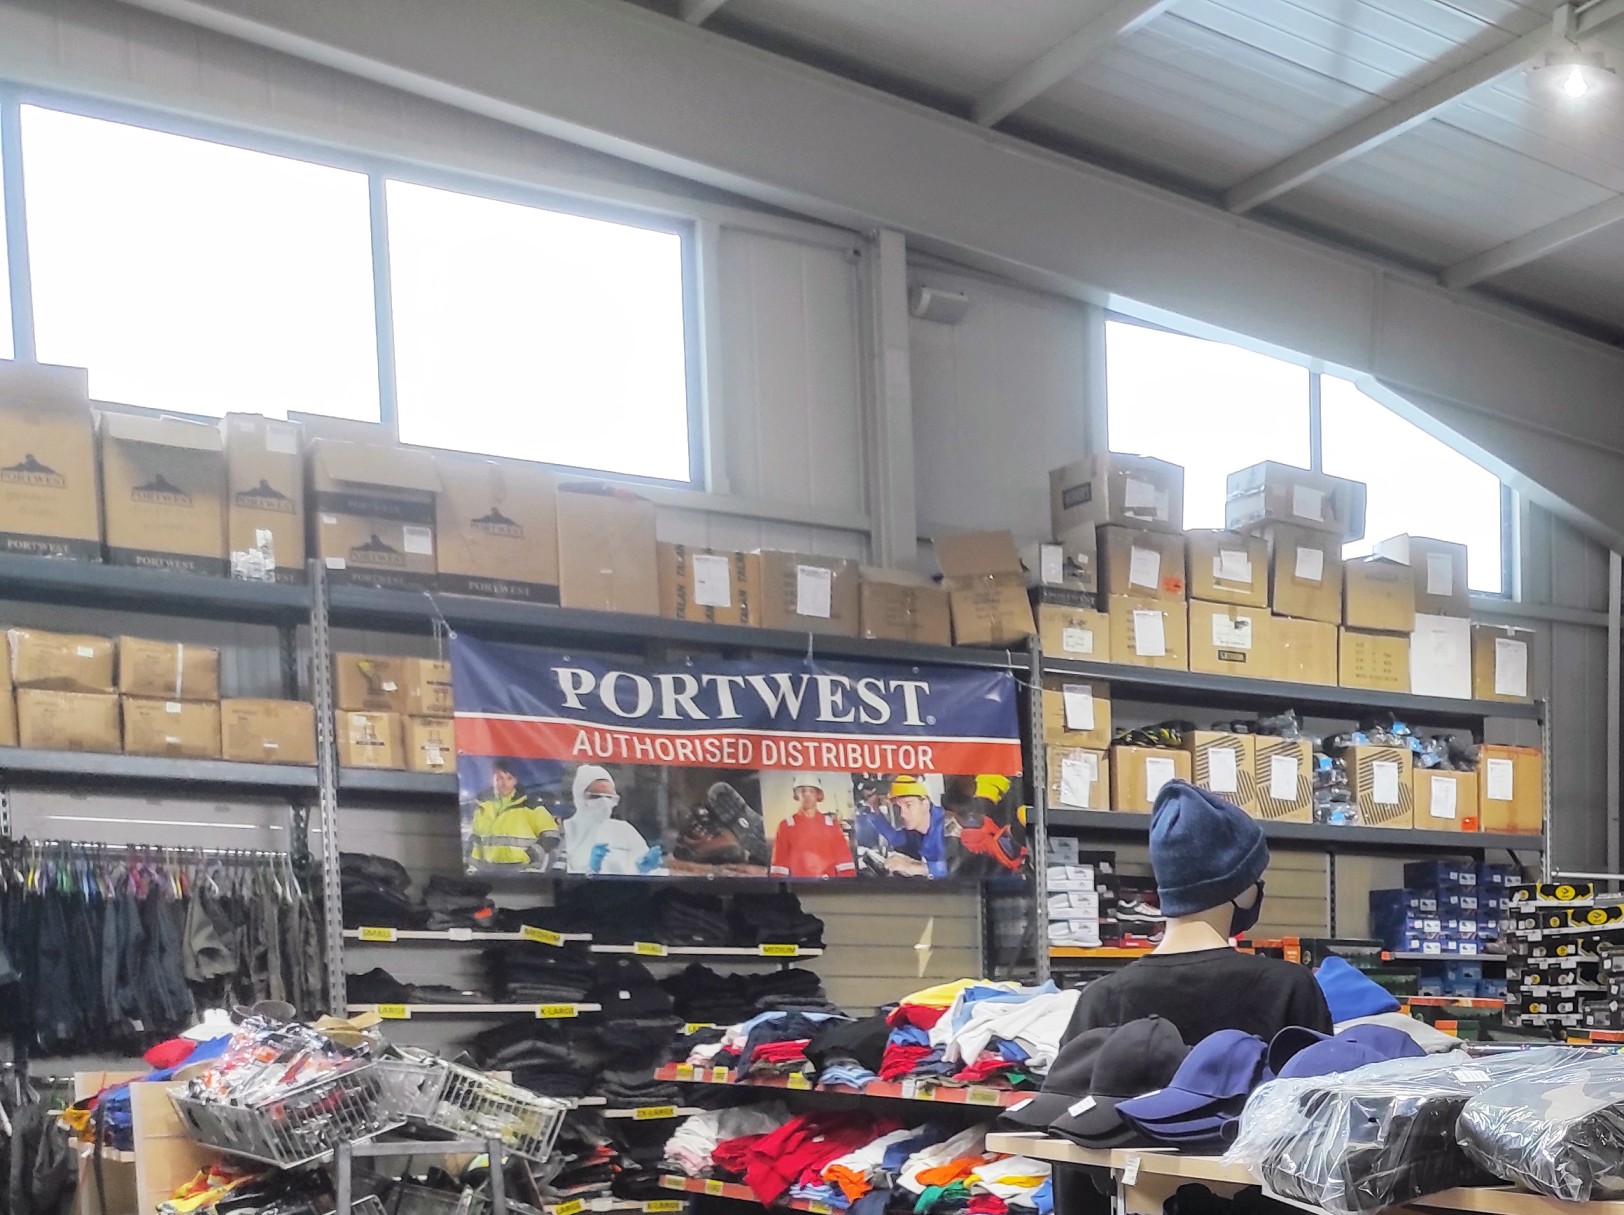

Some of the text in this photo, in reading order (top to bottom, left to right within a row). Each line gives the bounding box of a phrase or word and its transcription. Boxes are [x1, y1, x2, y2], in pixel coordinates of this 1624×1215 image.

[7, 539, 68, 552] PORTWEST
[136, 556, 194, 570] PORTWEST
[469, 580, 530, 596] PORTWEST
[551, 667, 931, 727] PORTWEST
[572, 730, 935, 771] AUTHORISED DISTRIBUTOR
